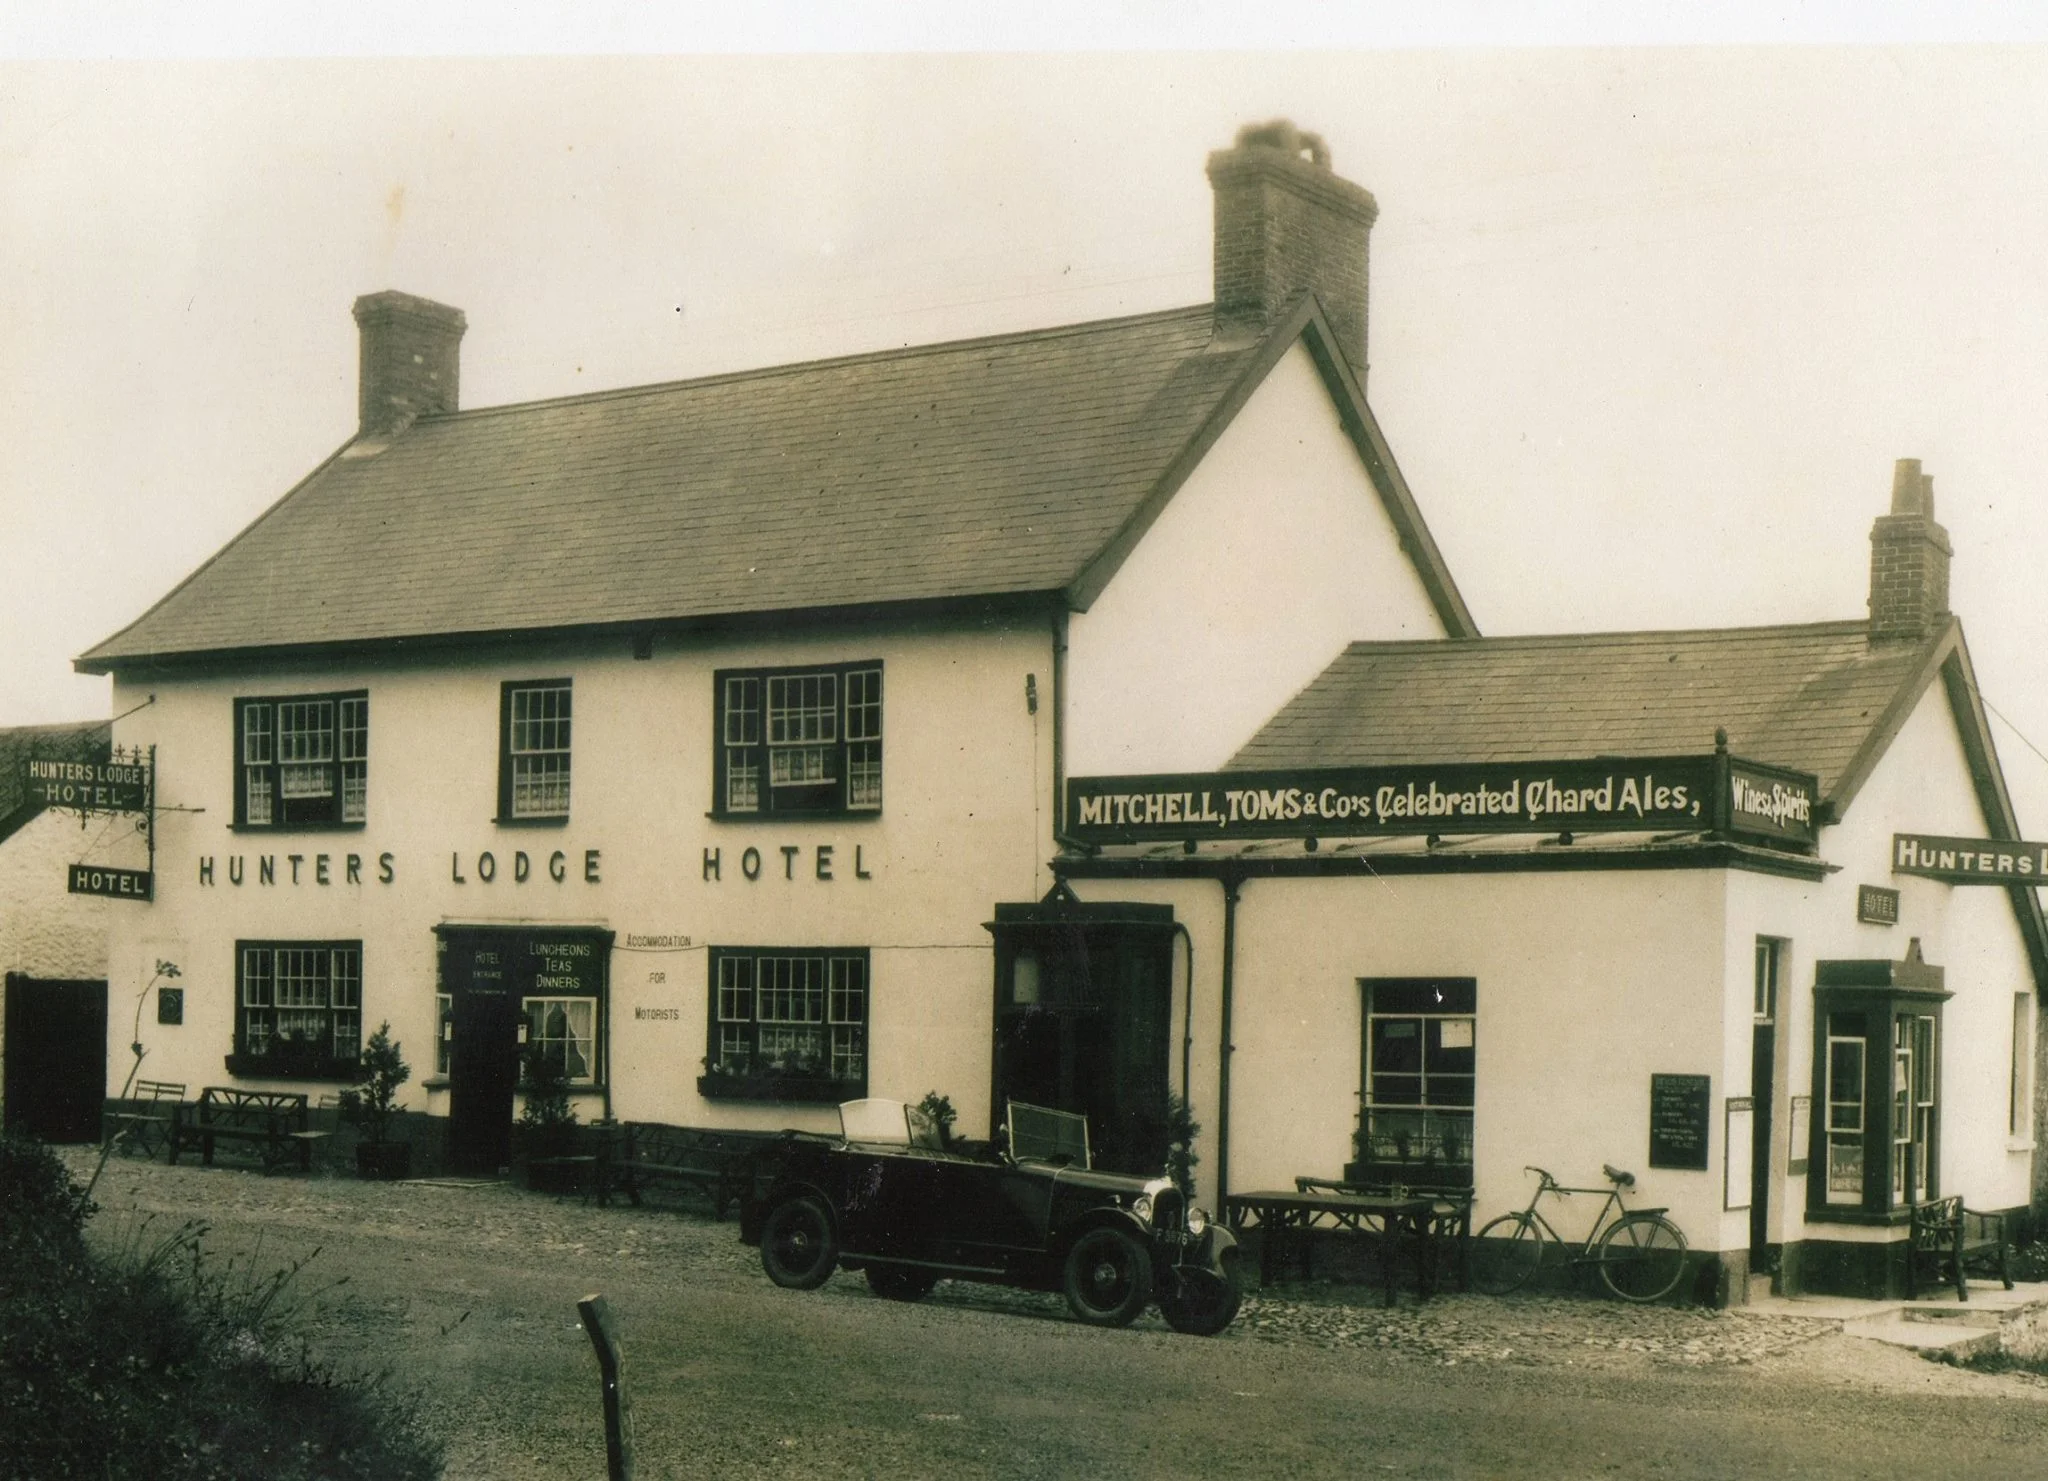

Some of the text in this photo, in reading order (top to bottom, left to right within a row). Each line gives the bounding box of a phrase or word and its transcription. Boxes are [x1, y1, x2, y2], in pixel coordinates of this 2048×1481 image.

[30, 761, 140, 785] HUNTERS LODGE
[46, 784, 122, 805] HOTEL
[1079, 791, 1226, 828] MITCHELL,
[1376, 779, 1520, 824] Celebrated
[1525, 776, 1613, 821] Chard
[1617, 774, 1700, 818] Ales,
[200, 844, 871, 886] HUNTERS LODGE HOTEL
[1898, 840, 2033, 874] HUNTERS
[76, 871, 144, 894] HOTEL
[529, 941, 591, 957] LUNCHEONS
[626, 933, 691, 947] ACCOMMODATION
[545, 957, 572, 972] TEAS
[536, 974, 580, 989] DINNERS
[649, 972, 666, 984] FOR
[635, 1007, 680, 1020] MOTORISTS
